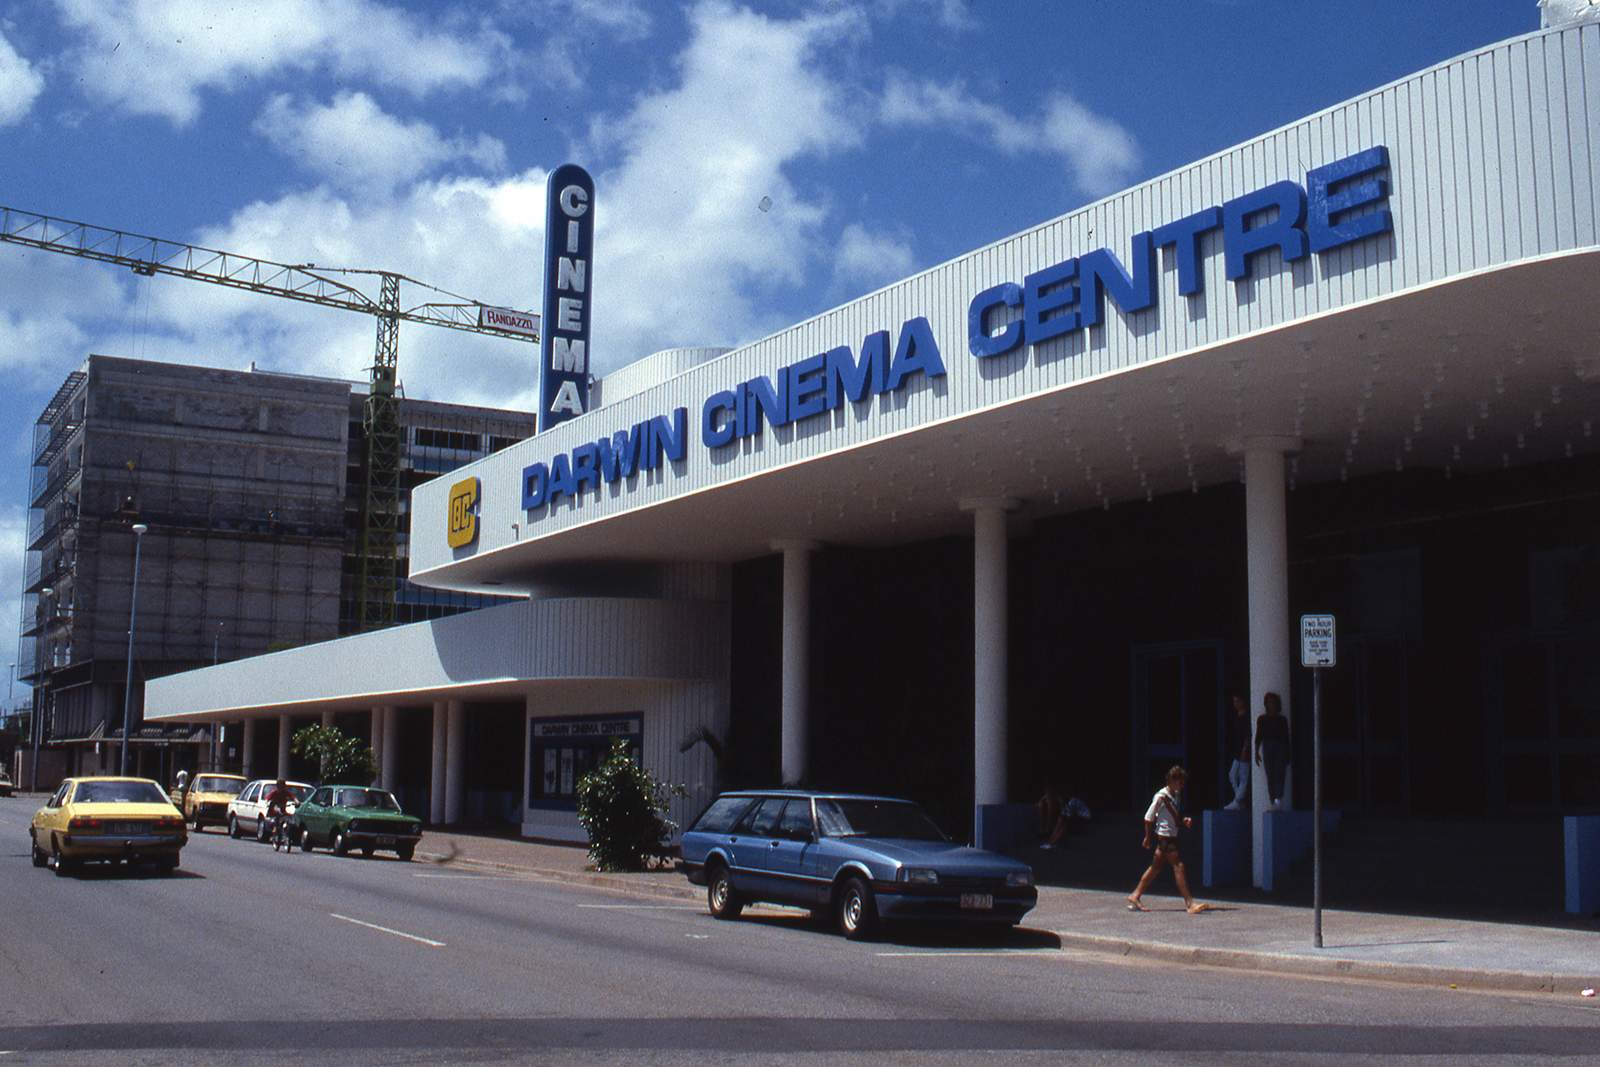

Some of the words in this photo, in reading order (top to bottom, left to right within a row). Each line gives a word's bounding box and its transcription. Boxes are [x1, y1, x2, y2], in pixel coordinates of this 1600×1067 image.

[487, 310, 533, 329] RANDAZZO
[521, 407, 688, 511] DARWIN
[702, 316, 946, 448] CINEMA
[968, 145, 1393, 358] CENTRE
[551, 184, 588, 427] CINEMA
[1304, 628, 1332, 638] PARKING
